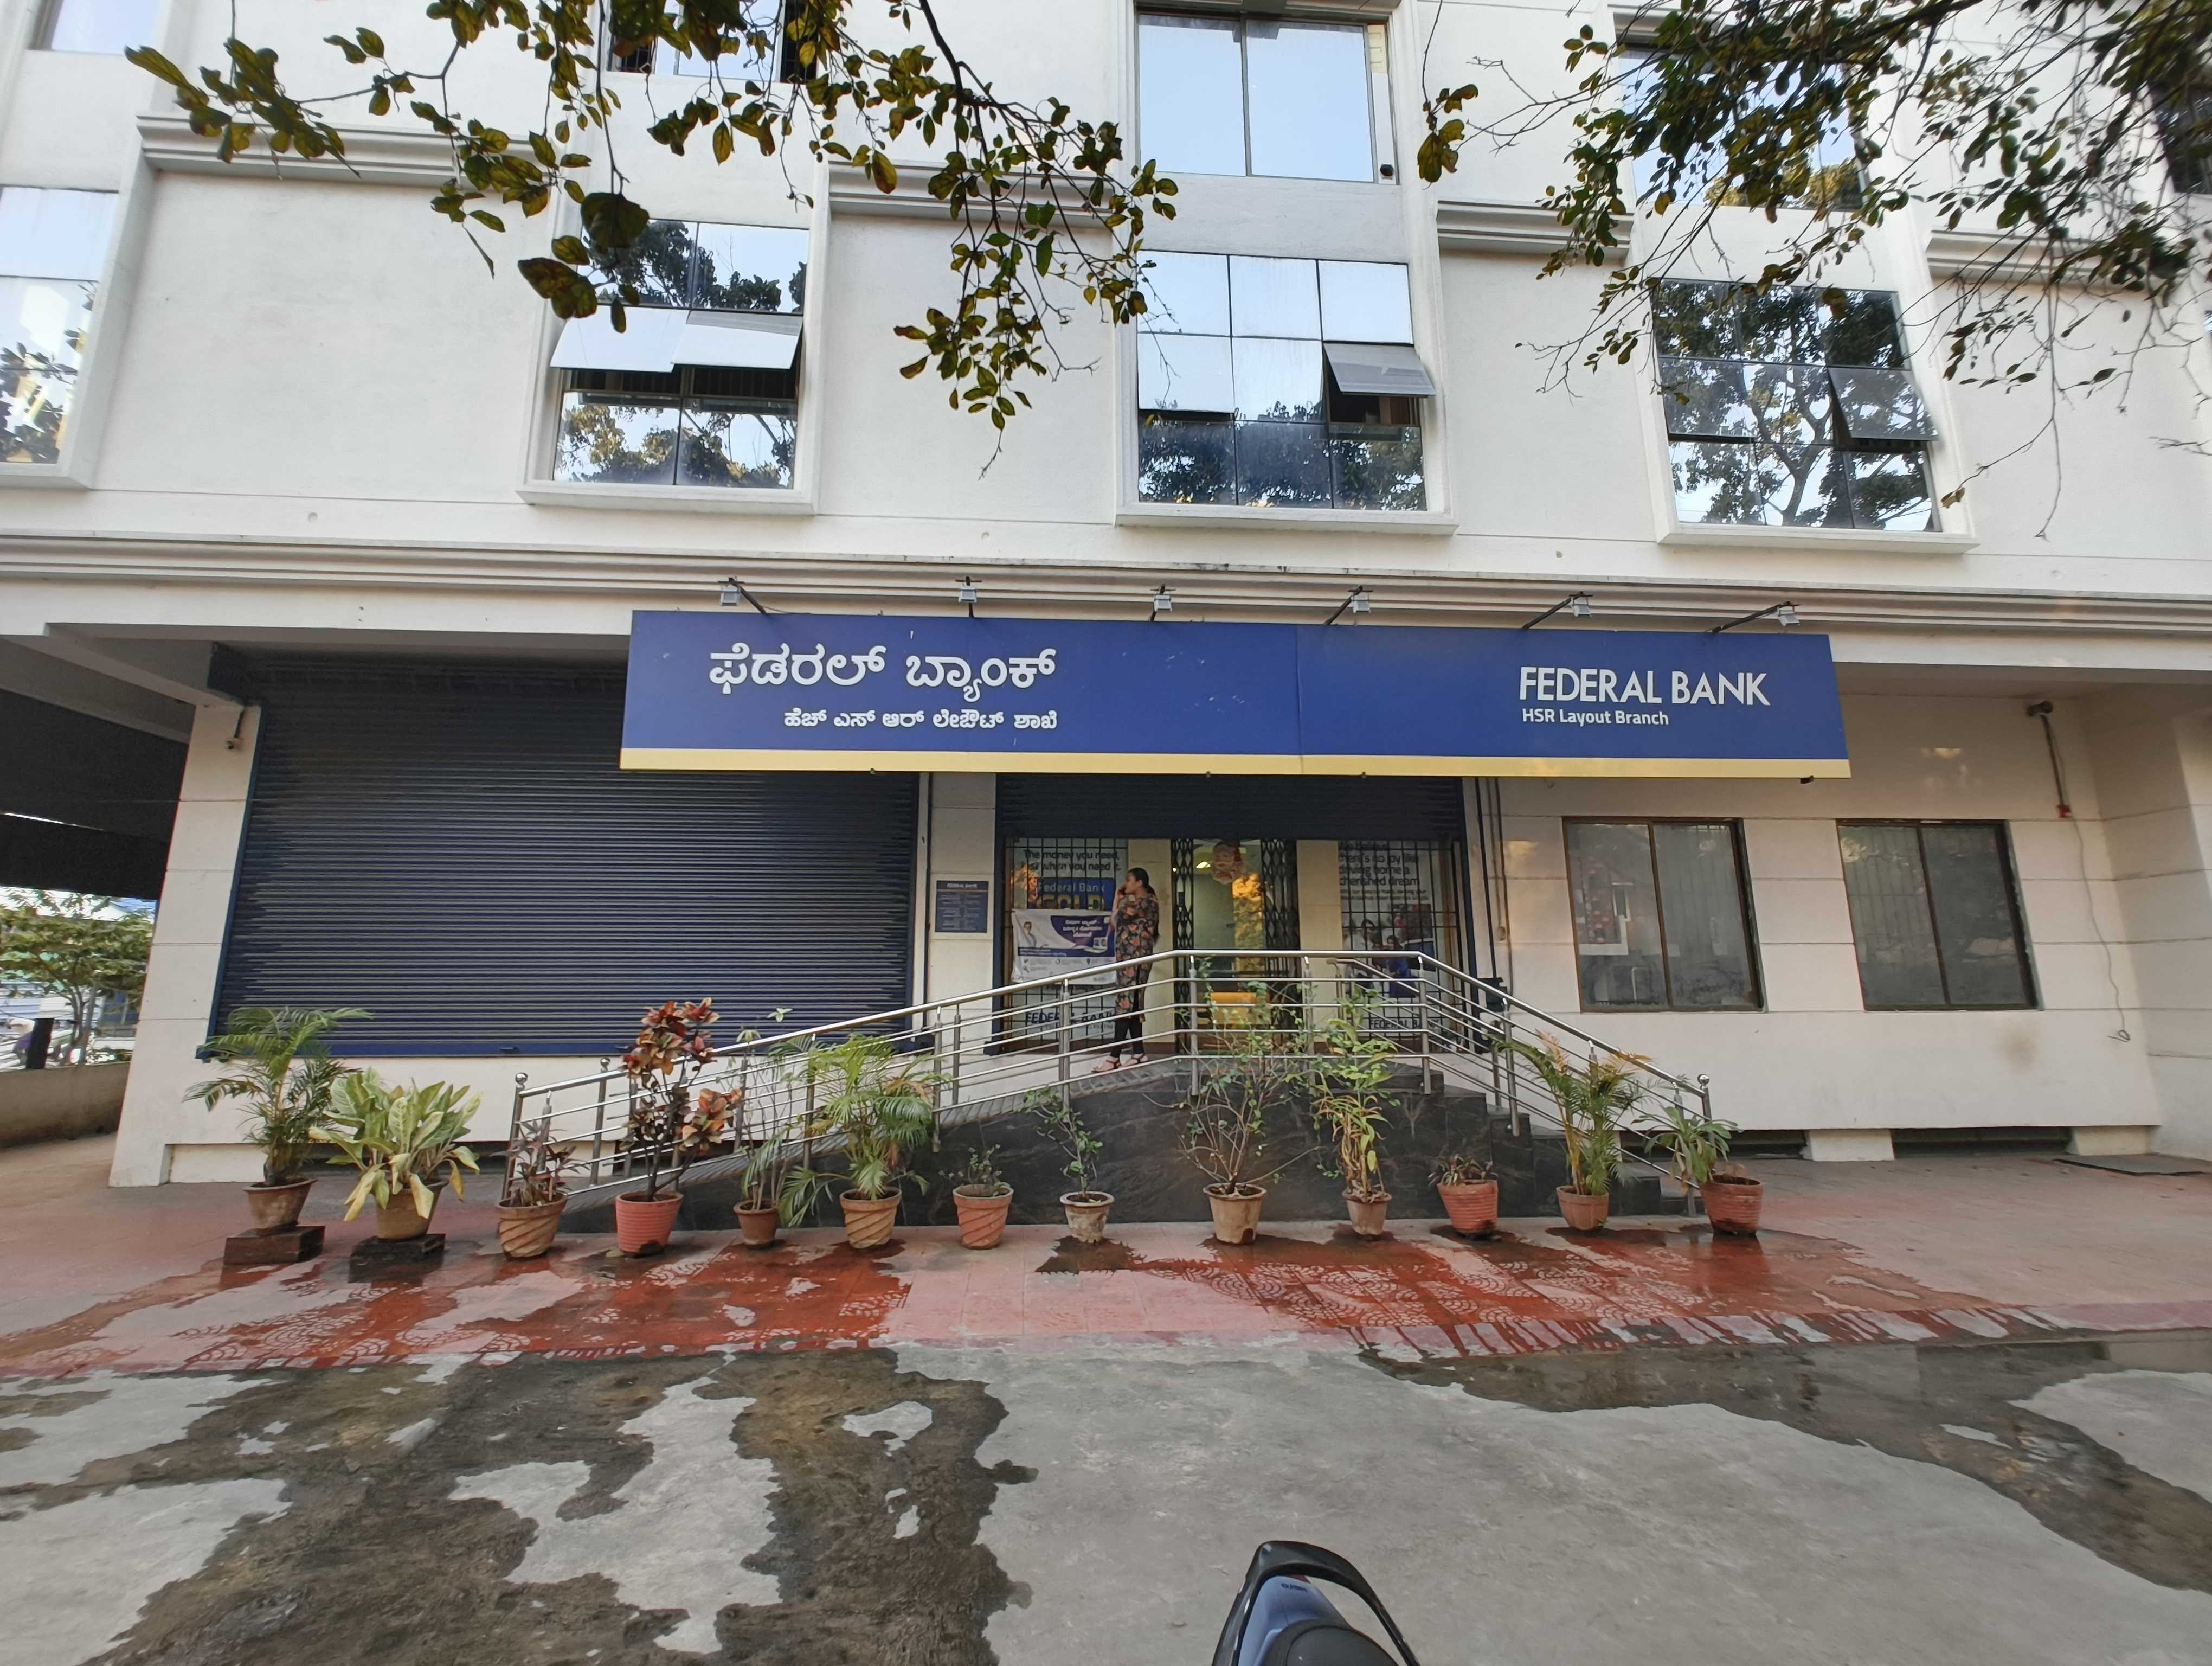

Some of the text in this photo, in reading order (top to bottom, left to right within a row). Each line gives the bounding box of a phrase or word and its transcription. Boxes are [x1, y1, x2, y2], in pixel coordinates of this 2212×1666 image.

[709, 642, 1057, 703] ಫೆಡರಲ್ ಬ್ಯಾಂಕ್
[1520, 667, 1771, 706] FEDERAL BANK
[784, 707, 827, 727] ಹೆಚ್
[833, 710, 876, 727] ಎಸ್
[882, 710, 925, 728] ಆರ್
[1014, 710, 1058, 729] ಶಾಖೆ
[1522, 708, 1669, 727] HSR Layout Branch
[1076, 852, 1092, 860] you
